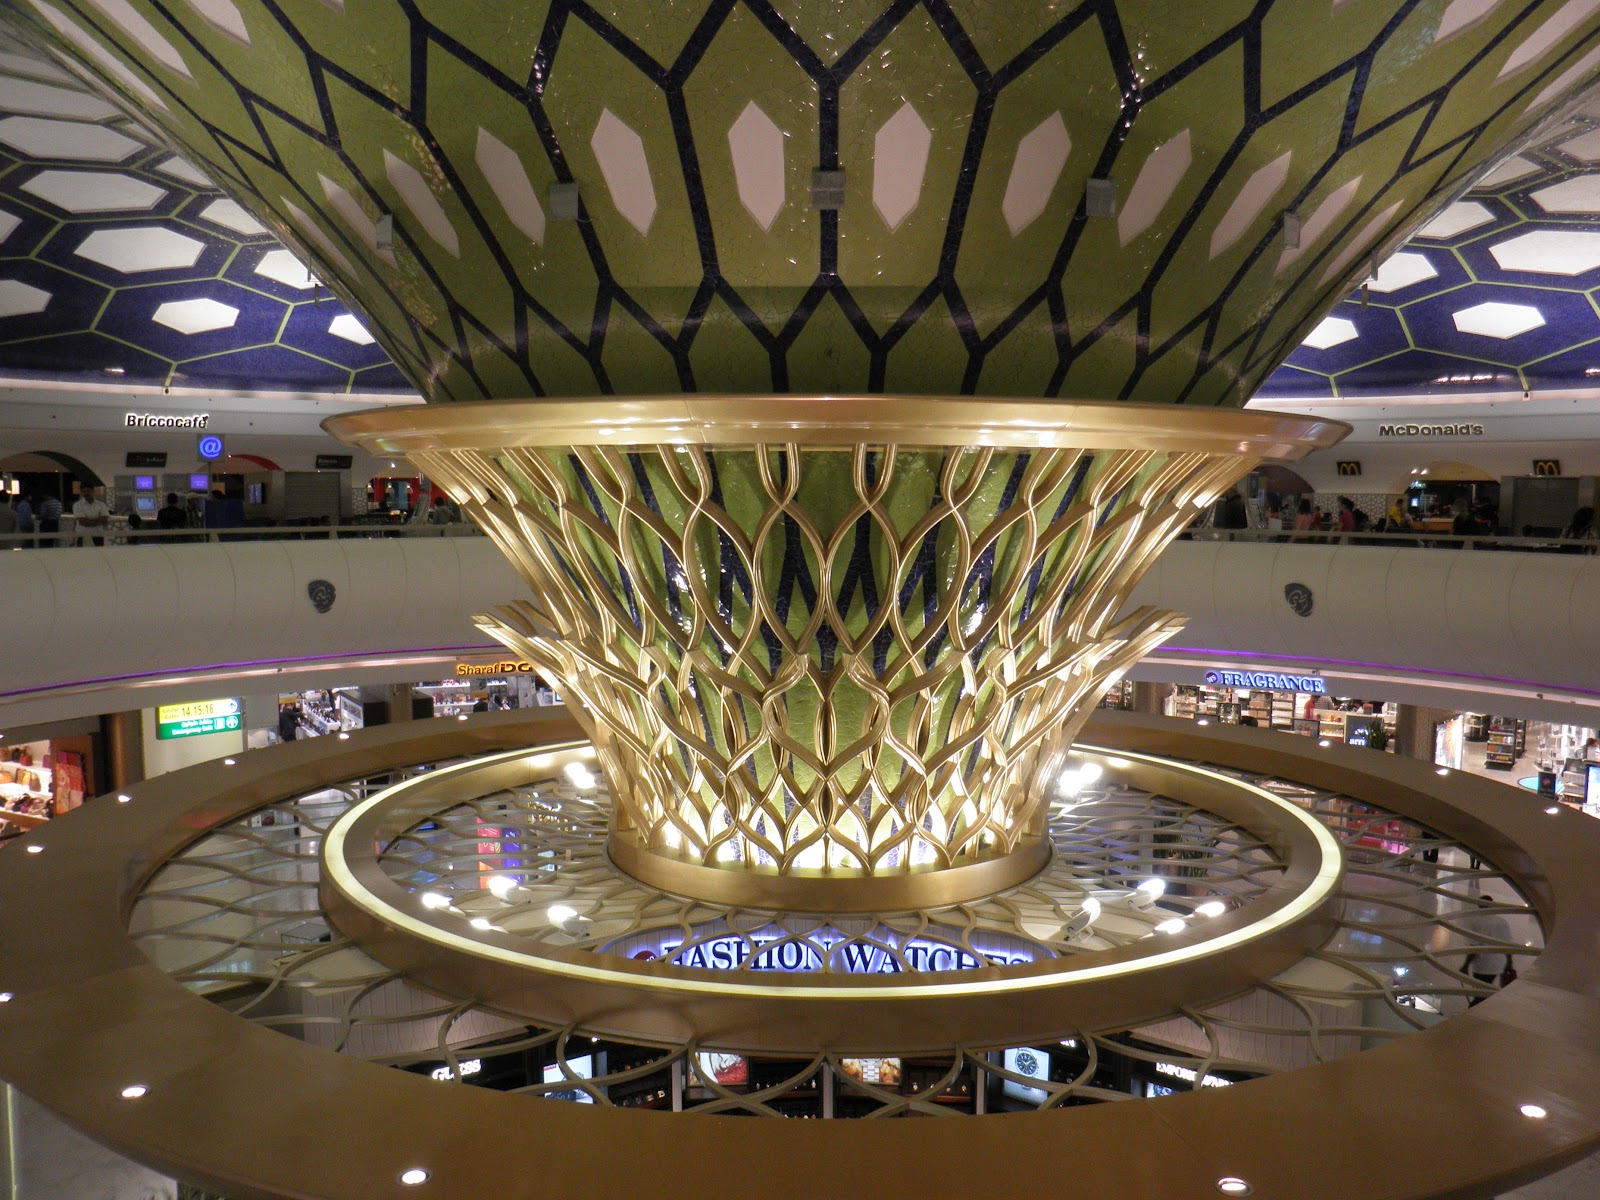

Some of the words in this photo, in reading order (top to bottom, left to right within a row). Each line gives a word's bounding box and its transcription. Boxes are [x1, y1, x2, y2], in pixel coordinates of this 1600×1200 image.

[1378, 423, 1484, 437] McDonald's
[457, 663, 499, 676] Sharaf
[1220, 671, 1325, 693] FRAGRANCE
[842, 941, 1030, 974] WATCH
